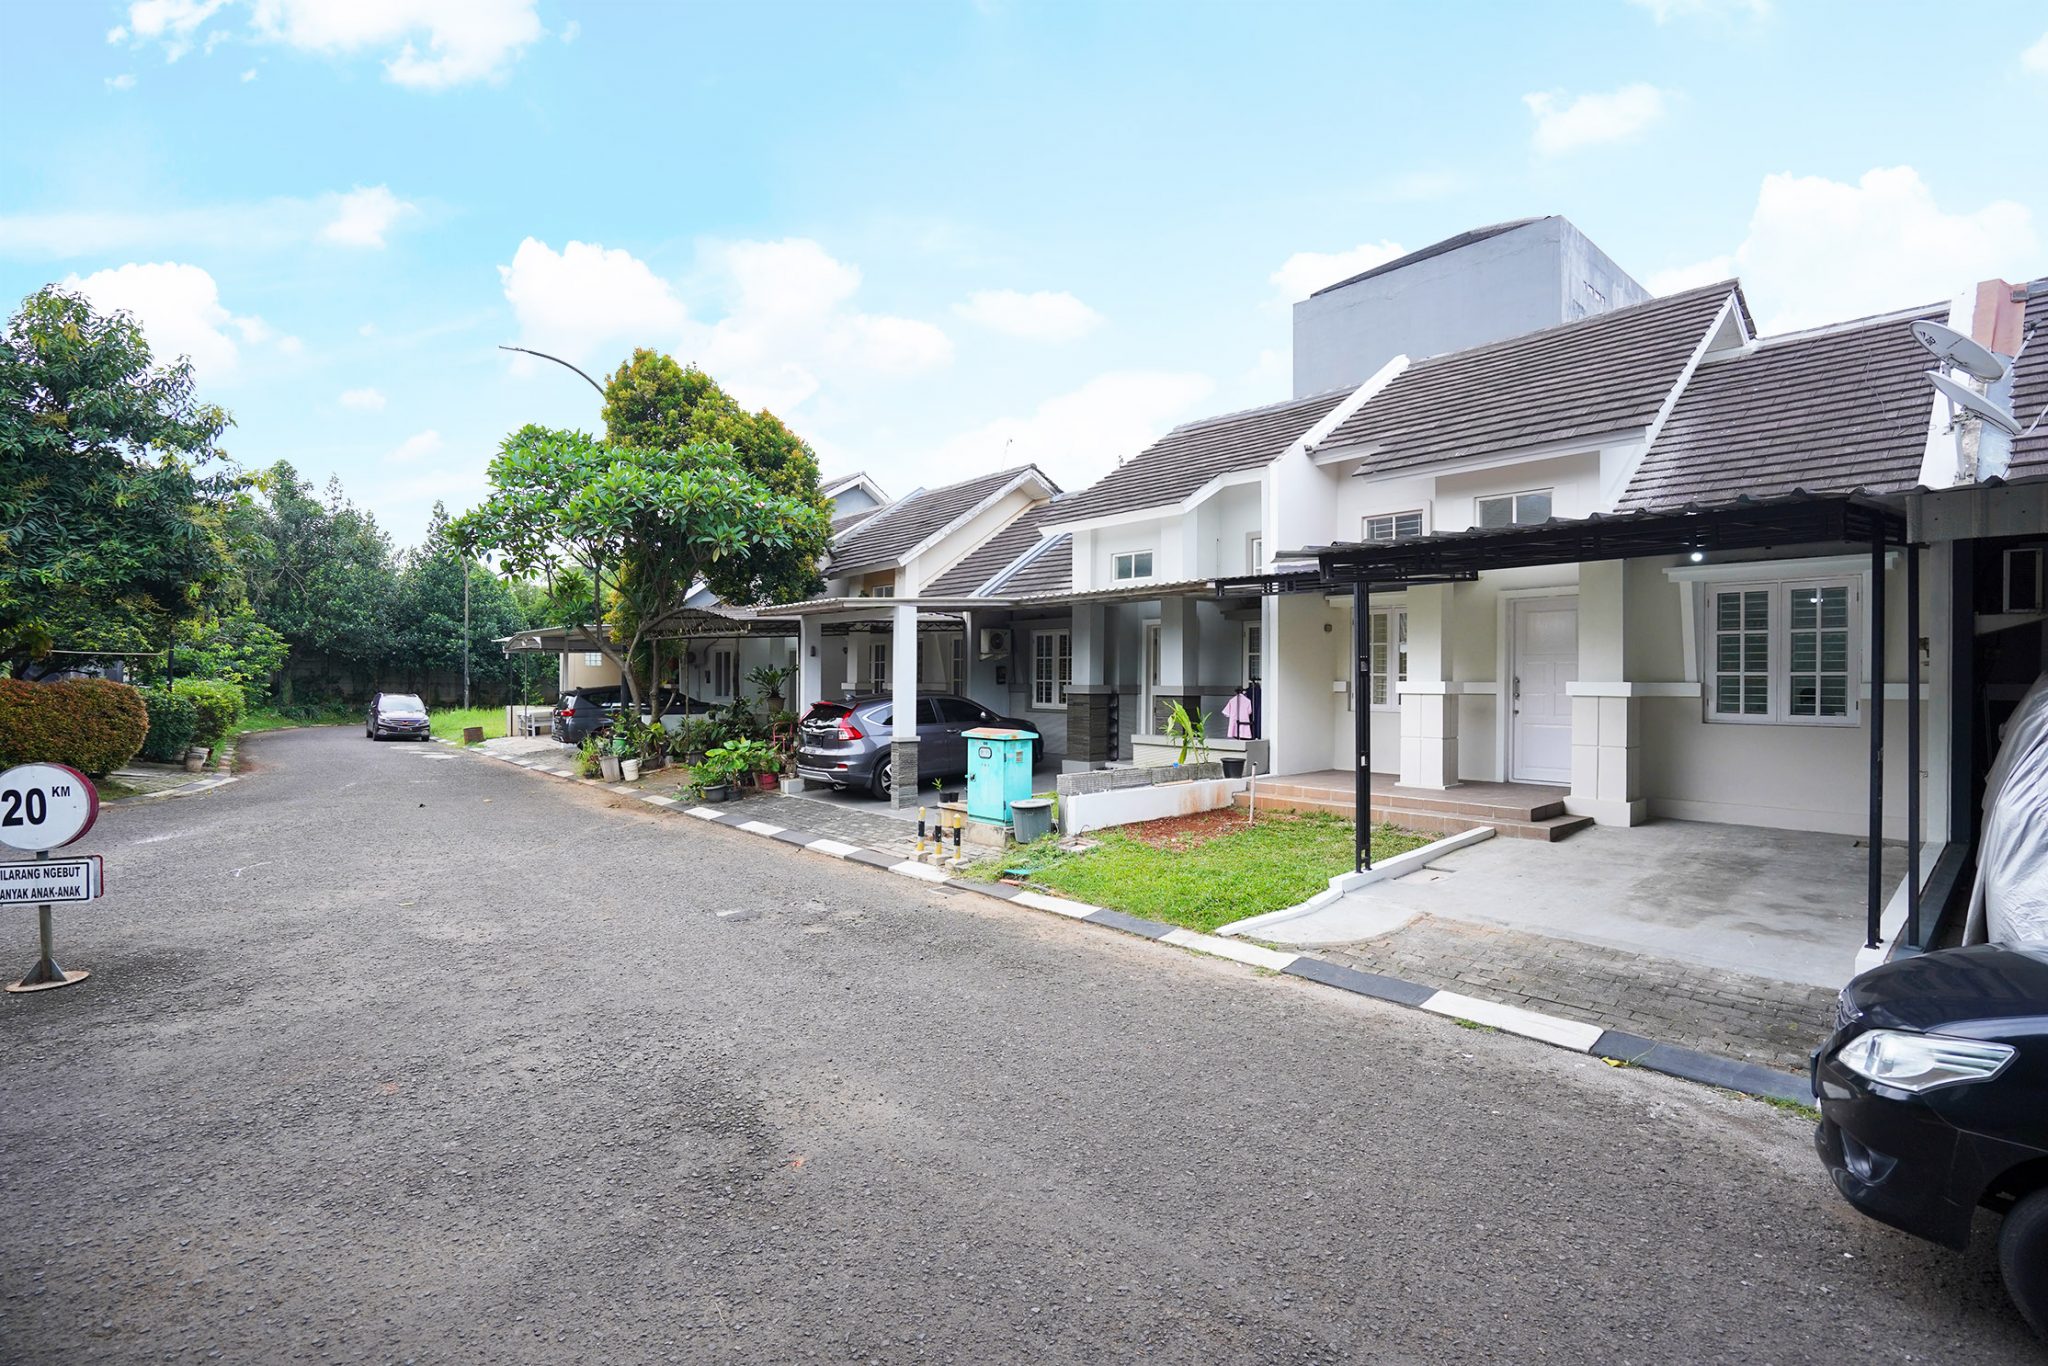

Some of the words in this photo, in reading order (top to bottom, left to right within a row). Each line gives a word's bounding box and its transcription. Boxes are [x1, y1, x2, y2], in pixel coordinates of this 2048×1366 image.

[1, 788, 47, 827] 20
[51, 786, 71, 797] KM
[0, 868, 41, 881] ILARANG
[43, 866, 81, 879] NGEBUT
[0, 888, 29, 900] ANYAK
[30, 885, 81, 899] ANAK-ANAK
